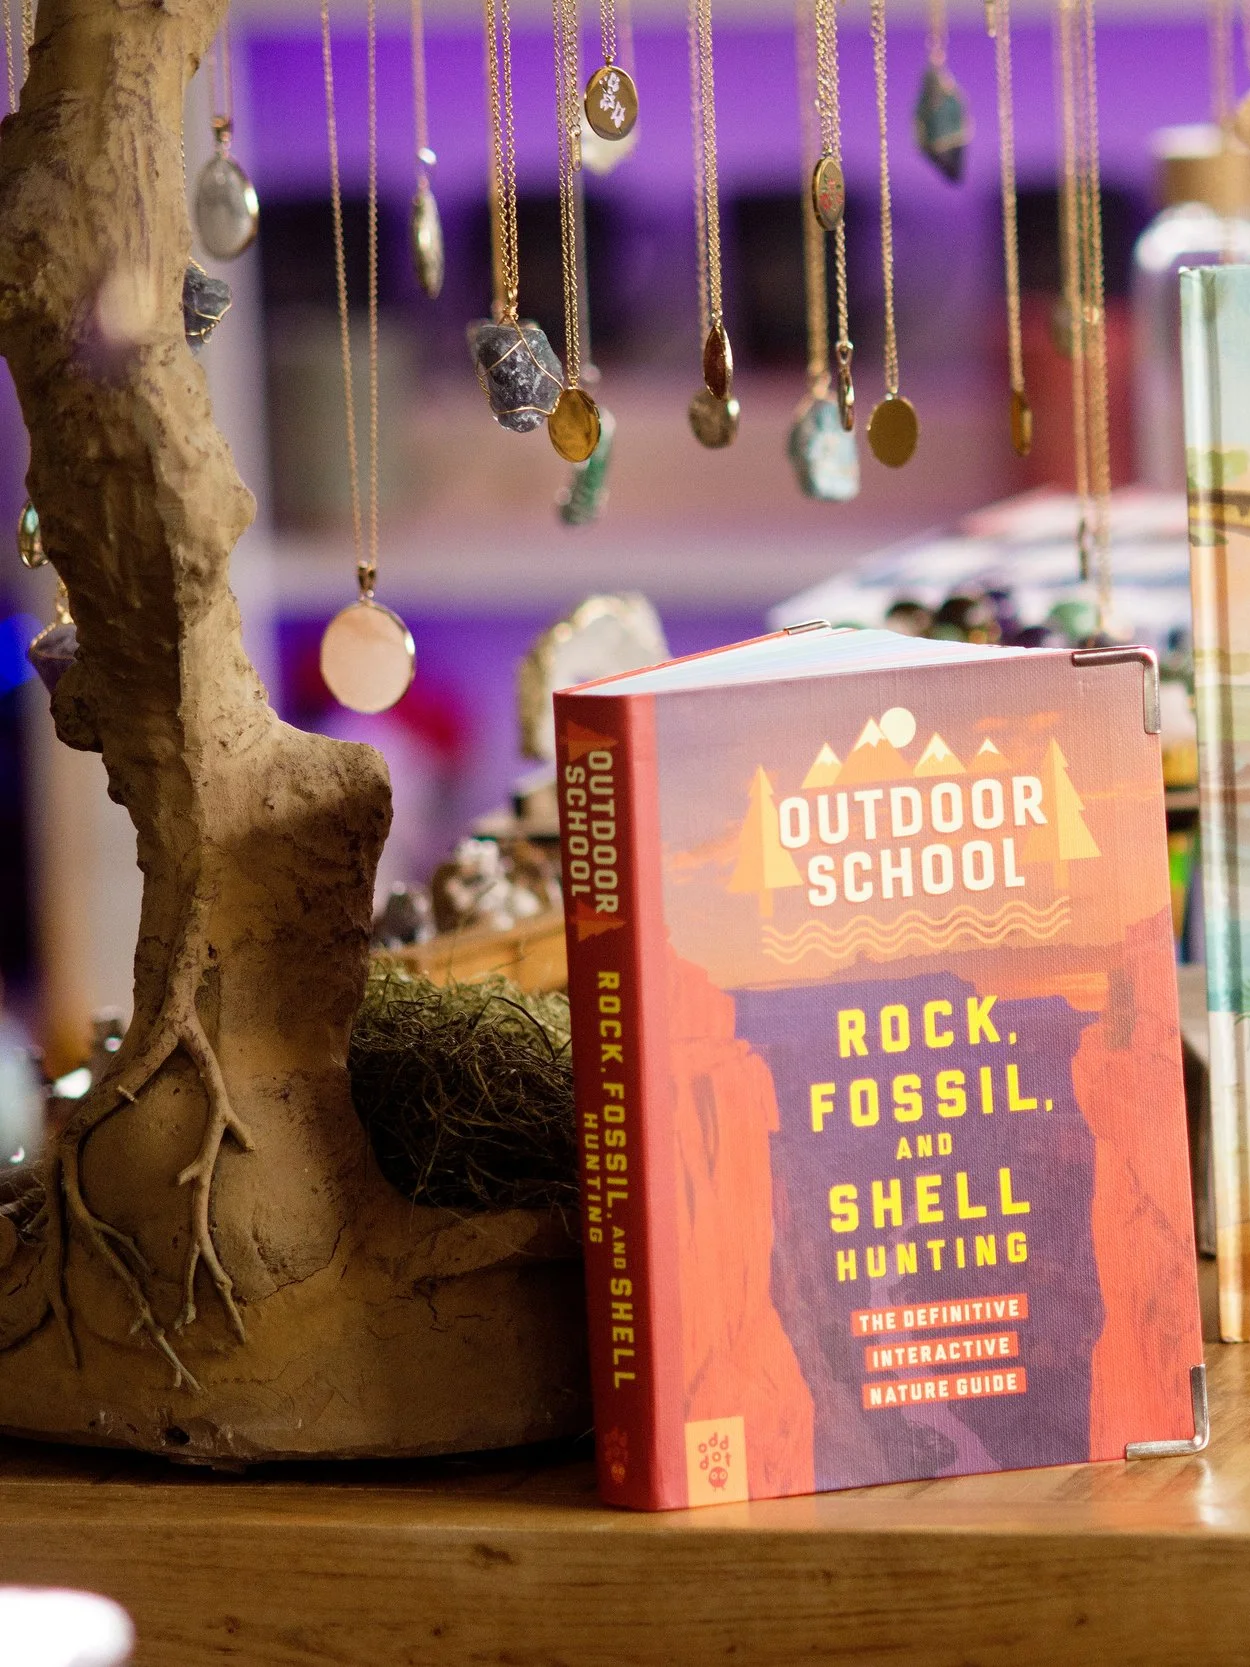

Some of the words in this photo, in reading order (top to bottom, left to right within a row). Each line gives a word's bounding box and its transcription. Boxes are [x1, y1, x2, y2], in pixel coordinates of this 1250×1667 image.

[565, 765, 591, 897] SCHOOL
[588, 750, 619, 914] OUTDOOR
[779, 775, 1048, 849] OUTDOOR
[807, 836, 1026, 906] SCHOOL
[837, 995, 1018, 1058] ROCK,
[809, 1064, 1054, 1132] FOSSIL,
[583, 1112, 603, 1244] HUNTING
[896, 1133, 953, 1160] AND
[828, 1167, 1031, 1233] SHELL
[612, 1227, 627, 1270] AND
[836, 1231, 1029, 1282] HUNTING
[610, 1278, 636, 1388] SHELL
[858, 1309, 896, 1333] THE
[903, 1299, 1020, 1328] DEFINITIVE
[871, 1338, 1010, 1369] INTERACTIVE
[869, 1377, 950, 1406] NATURE
[955, 1373, 1018, 1397] GUIDE
